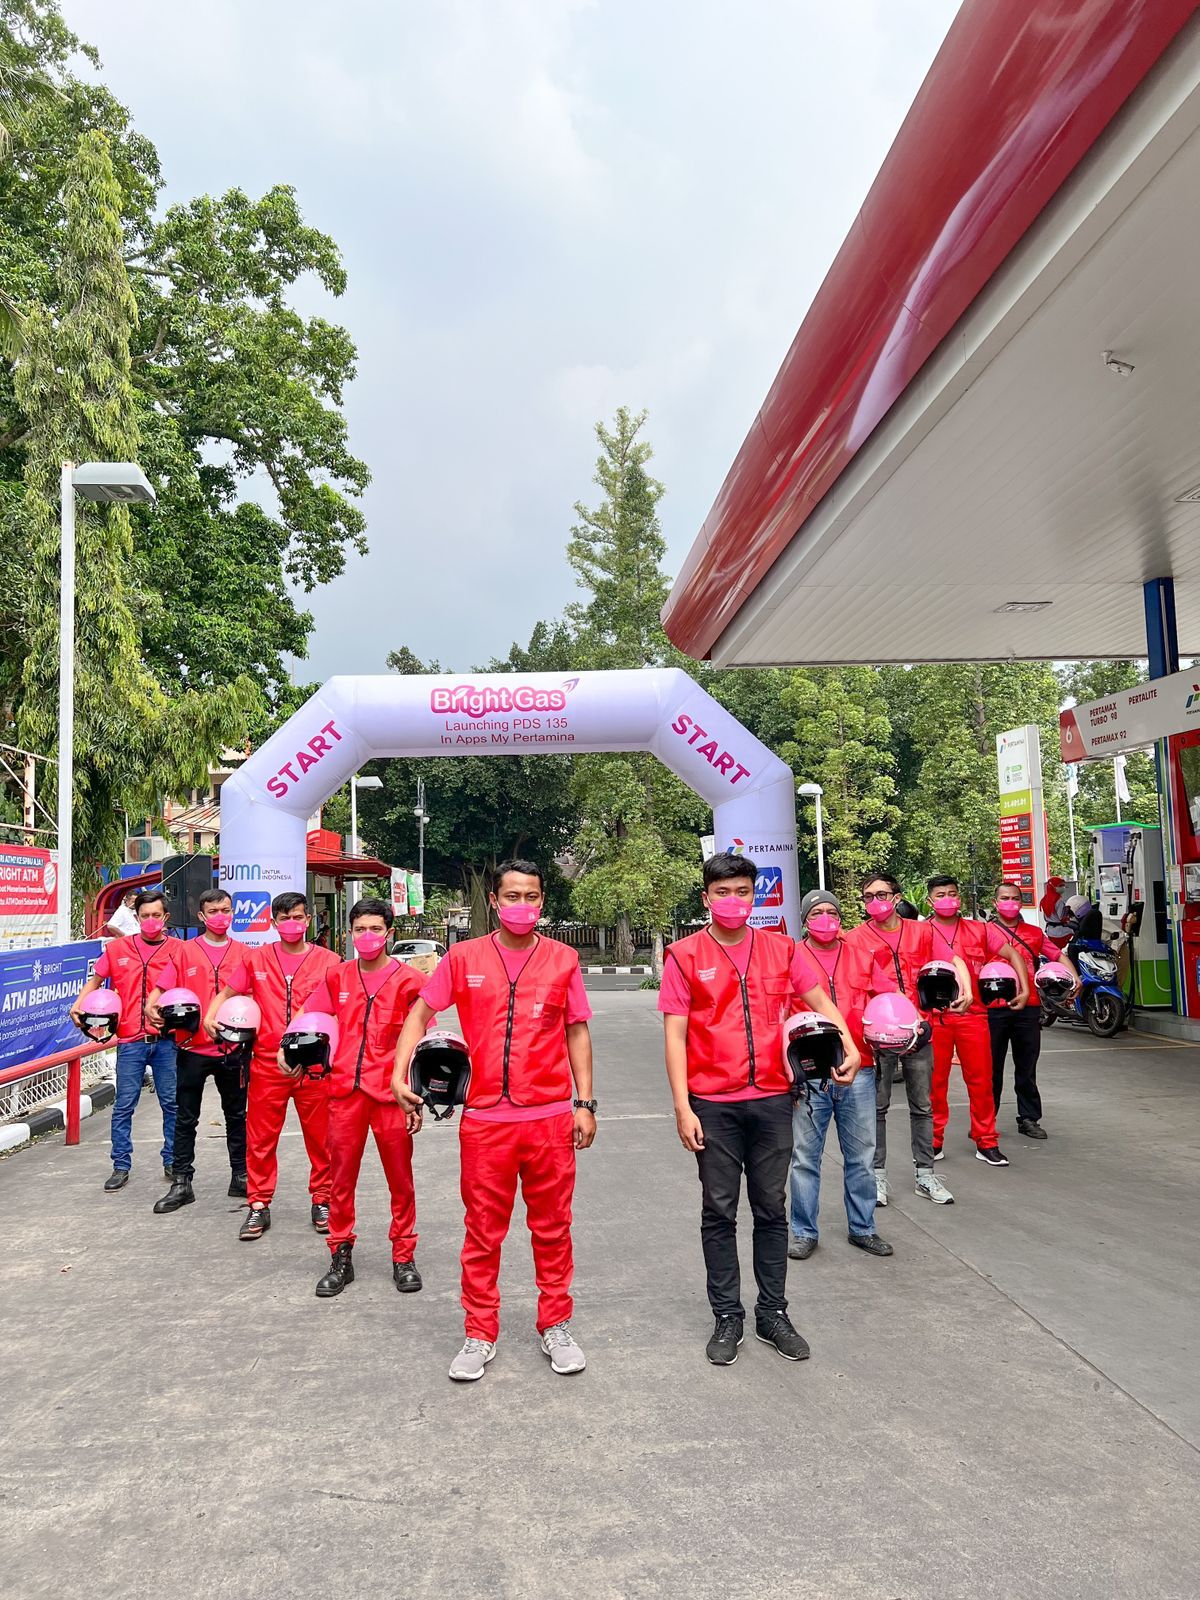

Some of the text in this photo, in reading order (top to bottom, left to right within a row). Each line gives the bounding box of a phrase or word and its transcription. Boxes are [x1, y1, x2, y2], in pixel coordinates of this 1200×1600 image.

[432, 687, 565, 716] Bright Gas
[1128, 689, 1158, 705] PERTALITE
[1089, 702, 1117, 717] PERTAMAX
[445, 717, 568, 732] Launching PDS 135
[1090, 712, 1118, 727] TURBO 98
[441, 732, 575, 745] In Apps My Pertamina
[1066, 725, 1073, 744] 6
[1091, 730, 1127, 746] PERTAMAX 92
[671, 714, 751, 785] START
[267, 720, 342, 798] START
[748, 844, 794, 853] PERTAMINA
[23, 868, 39, 882] ATM
[234, 899, 267, 918] My
[43, 962, 62, 975] BRIGHT
[2, 978, 84, 1013] ATM BERHADIAH
